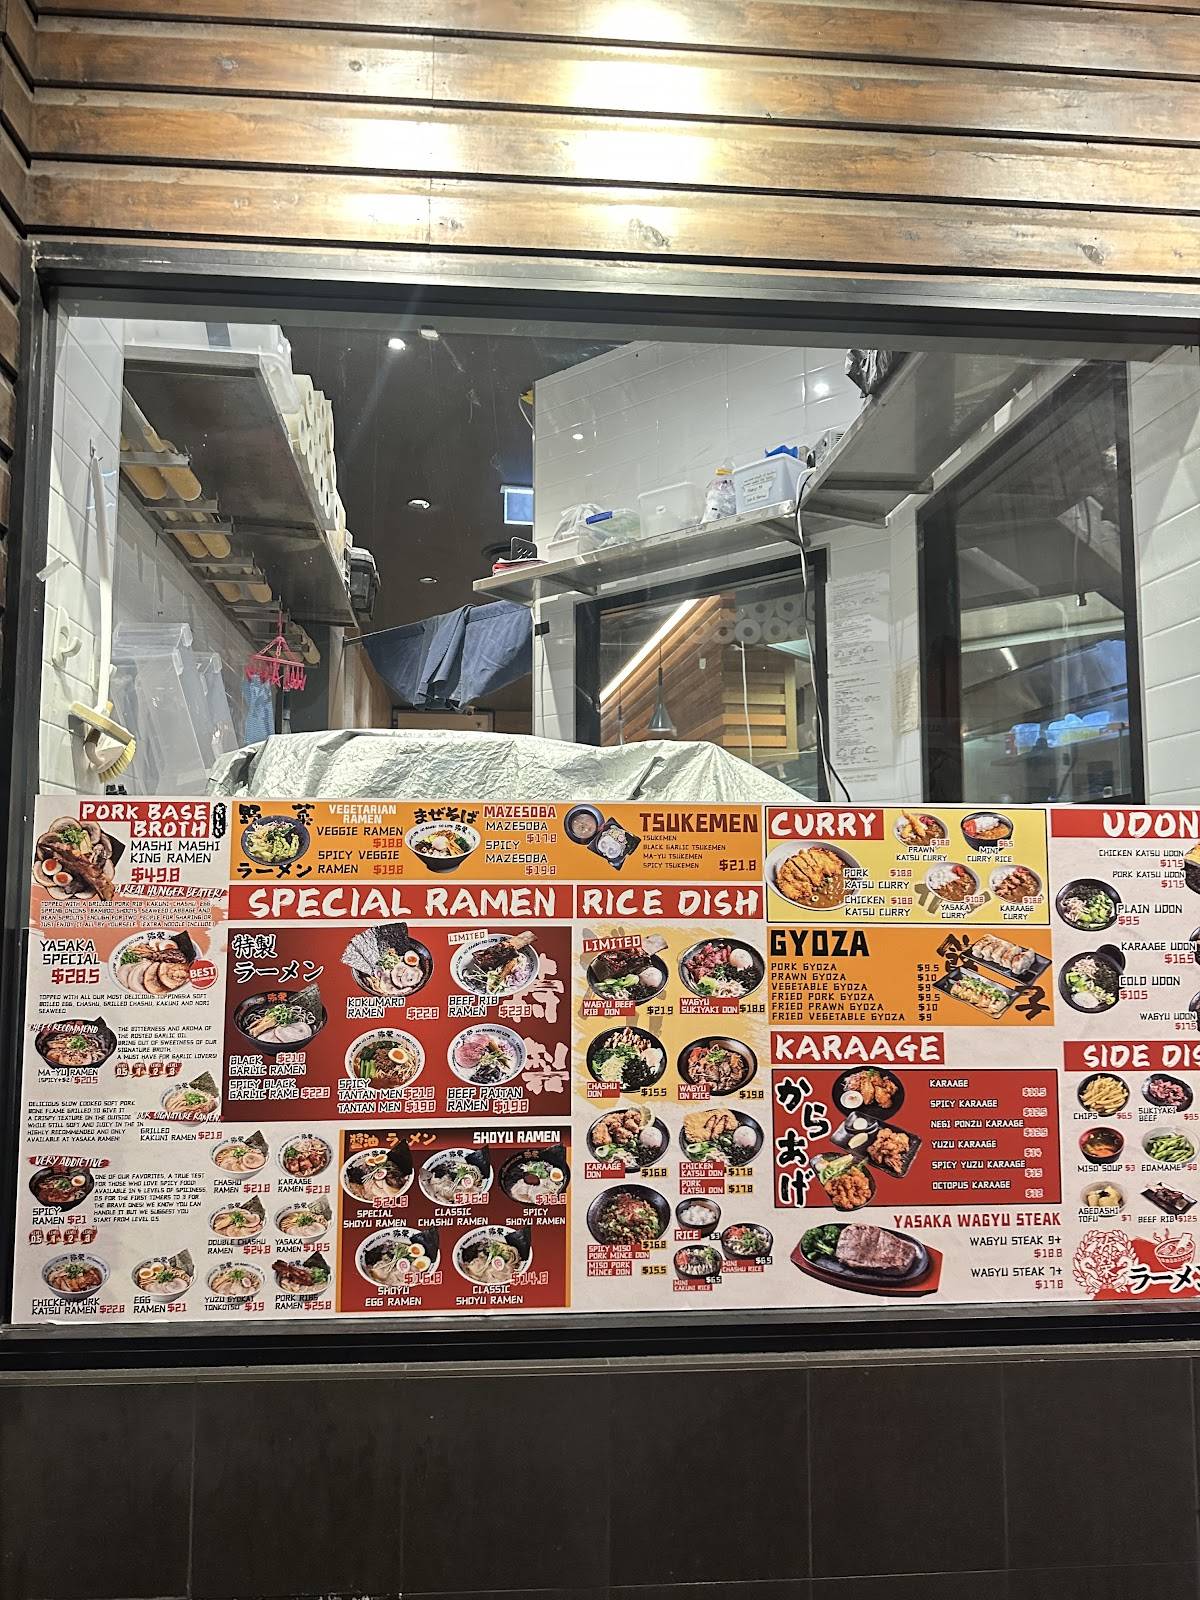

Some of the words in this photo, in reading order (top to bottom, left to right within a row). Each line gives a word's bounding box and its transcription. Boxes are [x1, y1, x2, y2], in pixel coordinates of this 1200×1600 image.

[82, 804, 139, 819] PORK
[153, 804, 207, 820] BASE
[329, 805, 397, 814] VEGETARIAN
[484, 806, 556, 818] MAZESOBA
[343, 815, 382, 824] RAMEN
[414, 807, 479, 824] まぜそば
[486, 822, 548, 830] MAZESOBA
[640, 813, 758, 832] TSUKEMEN
[771, 812, 876, 837] CURRY
[1103, 812, 1198, 837] UDON
[133, 821, 207, 837] BROTH
[317, 827, 357, 836] VEGGIE
[364, 827, 403, 835] RAMEN
[131, 841, 172, 851] MASHI
[178, 841, 220, 851] MASHI
[486, 841, 520, 850] SPICY
[131, 853, 161, 863] KING
[167, 853, 211, 863] RAMEN
[318, 851, 352, 859] SPICY
[359, 851, 399, 859] VEGGIE
[486, 854, 548, 863] MAZESOBA
[318, 865, 358, 873] RAMEN
[719, 859, 756, 871] $21.8
[131, 868, 180, 882] $49.8
[845, 881, 874, 889] KATSU
[878, 881, 910, 890] CURRY
[249, 888, 412, 918] SPECIAL
[426, 888, 555, 917] RAMEN
[583, 889, 664, 915] RICE
[678, 890, 759, 915] DISH
[845, 896, 885, 904] CHICKEN
[845, 908, 874, 916] KATSU
[880, 908, 910, 916] CURRY
[1118, 905, 1149, 913] PLAIN
[1155, 905, 1182, 913] UDON
[449, 931, 485, 942] LIMITED
[40, 940, 94, 951] YASAKA
[233, 935, 277, 958] 特製
[585, 936, 641, 952] LIMITED
[771, 930, 869, 956] GYOZA
[1122, 942, 1166, 950] KARAAGE
[43, 954, 100, 965] SPECIAL
[51, 968, 99, 984] $28.5
[190, 968, 215, 977] BEST
[234, 961, 324, 983] ラーメン
[1120, 977, 1146, 985] COLD
[1152, 977, 1180, 985] UDON
[347, 998, 404, 1007] KOKUMARO
[449, 997, 475, 1005] BEEF
[479, 996, 498, 1005] RIB
[347, 1008, 384, 1017] RAMEN
[449, 1007, 486, 1016] RAMEN
[776, 1035, 940, 1061] KARAAGE
[1084, 1044, 1150, 1068] SIDE
[231, 1057, 262, 1065] BLACK
[230, 1066, 266, 1075] GARLIC
[270, 1066, 306, 1074] RAMEN
[930, 1100, 955, 1108] SPICY
[473, 1132, 513, 1143] SHOYU
[517, 1131, 560, 1143] RAMEN
[777, 1078, 830, 1206] からあげ
[35, 1156, 56, 1164] VERY
[33, 1207, 61, 1215] SPICY
[67, 1216, 86, 1224] $21
[376, 1219, 406, 1227] RAMEN
[418, 1219, 453, 1227] CHASHU
[894, 1215, 952, 1228] YASAKA
[958, 1214, 1010, 1227] WAGYU
[1016, 1213, 1061, 1226] STEAK
[676, 1231, 699, 1239] RICE
[970, 1236, 1007, 1246] WAGYU
[1012, 1236, 1043, 1245] STEAK
[1048, 1236, 1062, 1244] 9+
[378, 1286, 410, 1295] SHOYU
[473, 1286, 510, 1294] CLASSIC
[365, 1298, 384, 1306] EGG
[388, 1297, 422, 1306] RAMEN
[456, 1297, 486, 1305] SHOYU
[490, 1296, 523, 1304] RAMEN
[133, 1305, 166, 1313] RAMEN
[168, 1304, 187, 1312] $21
